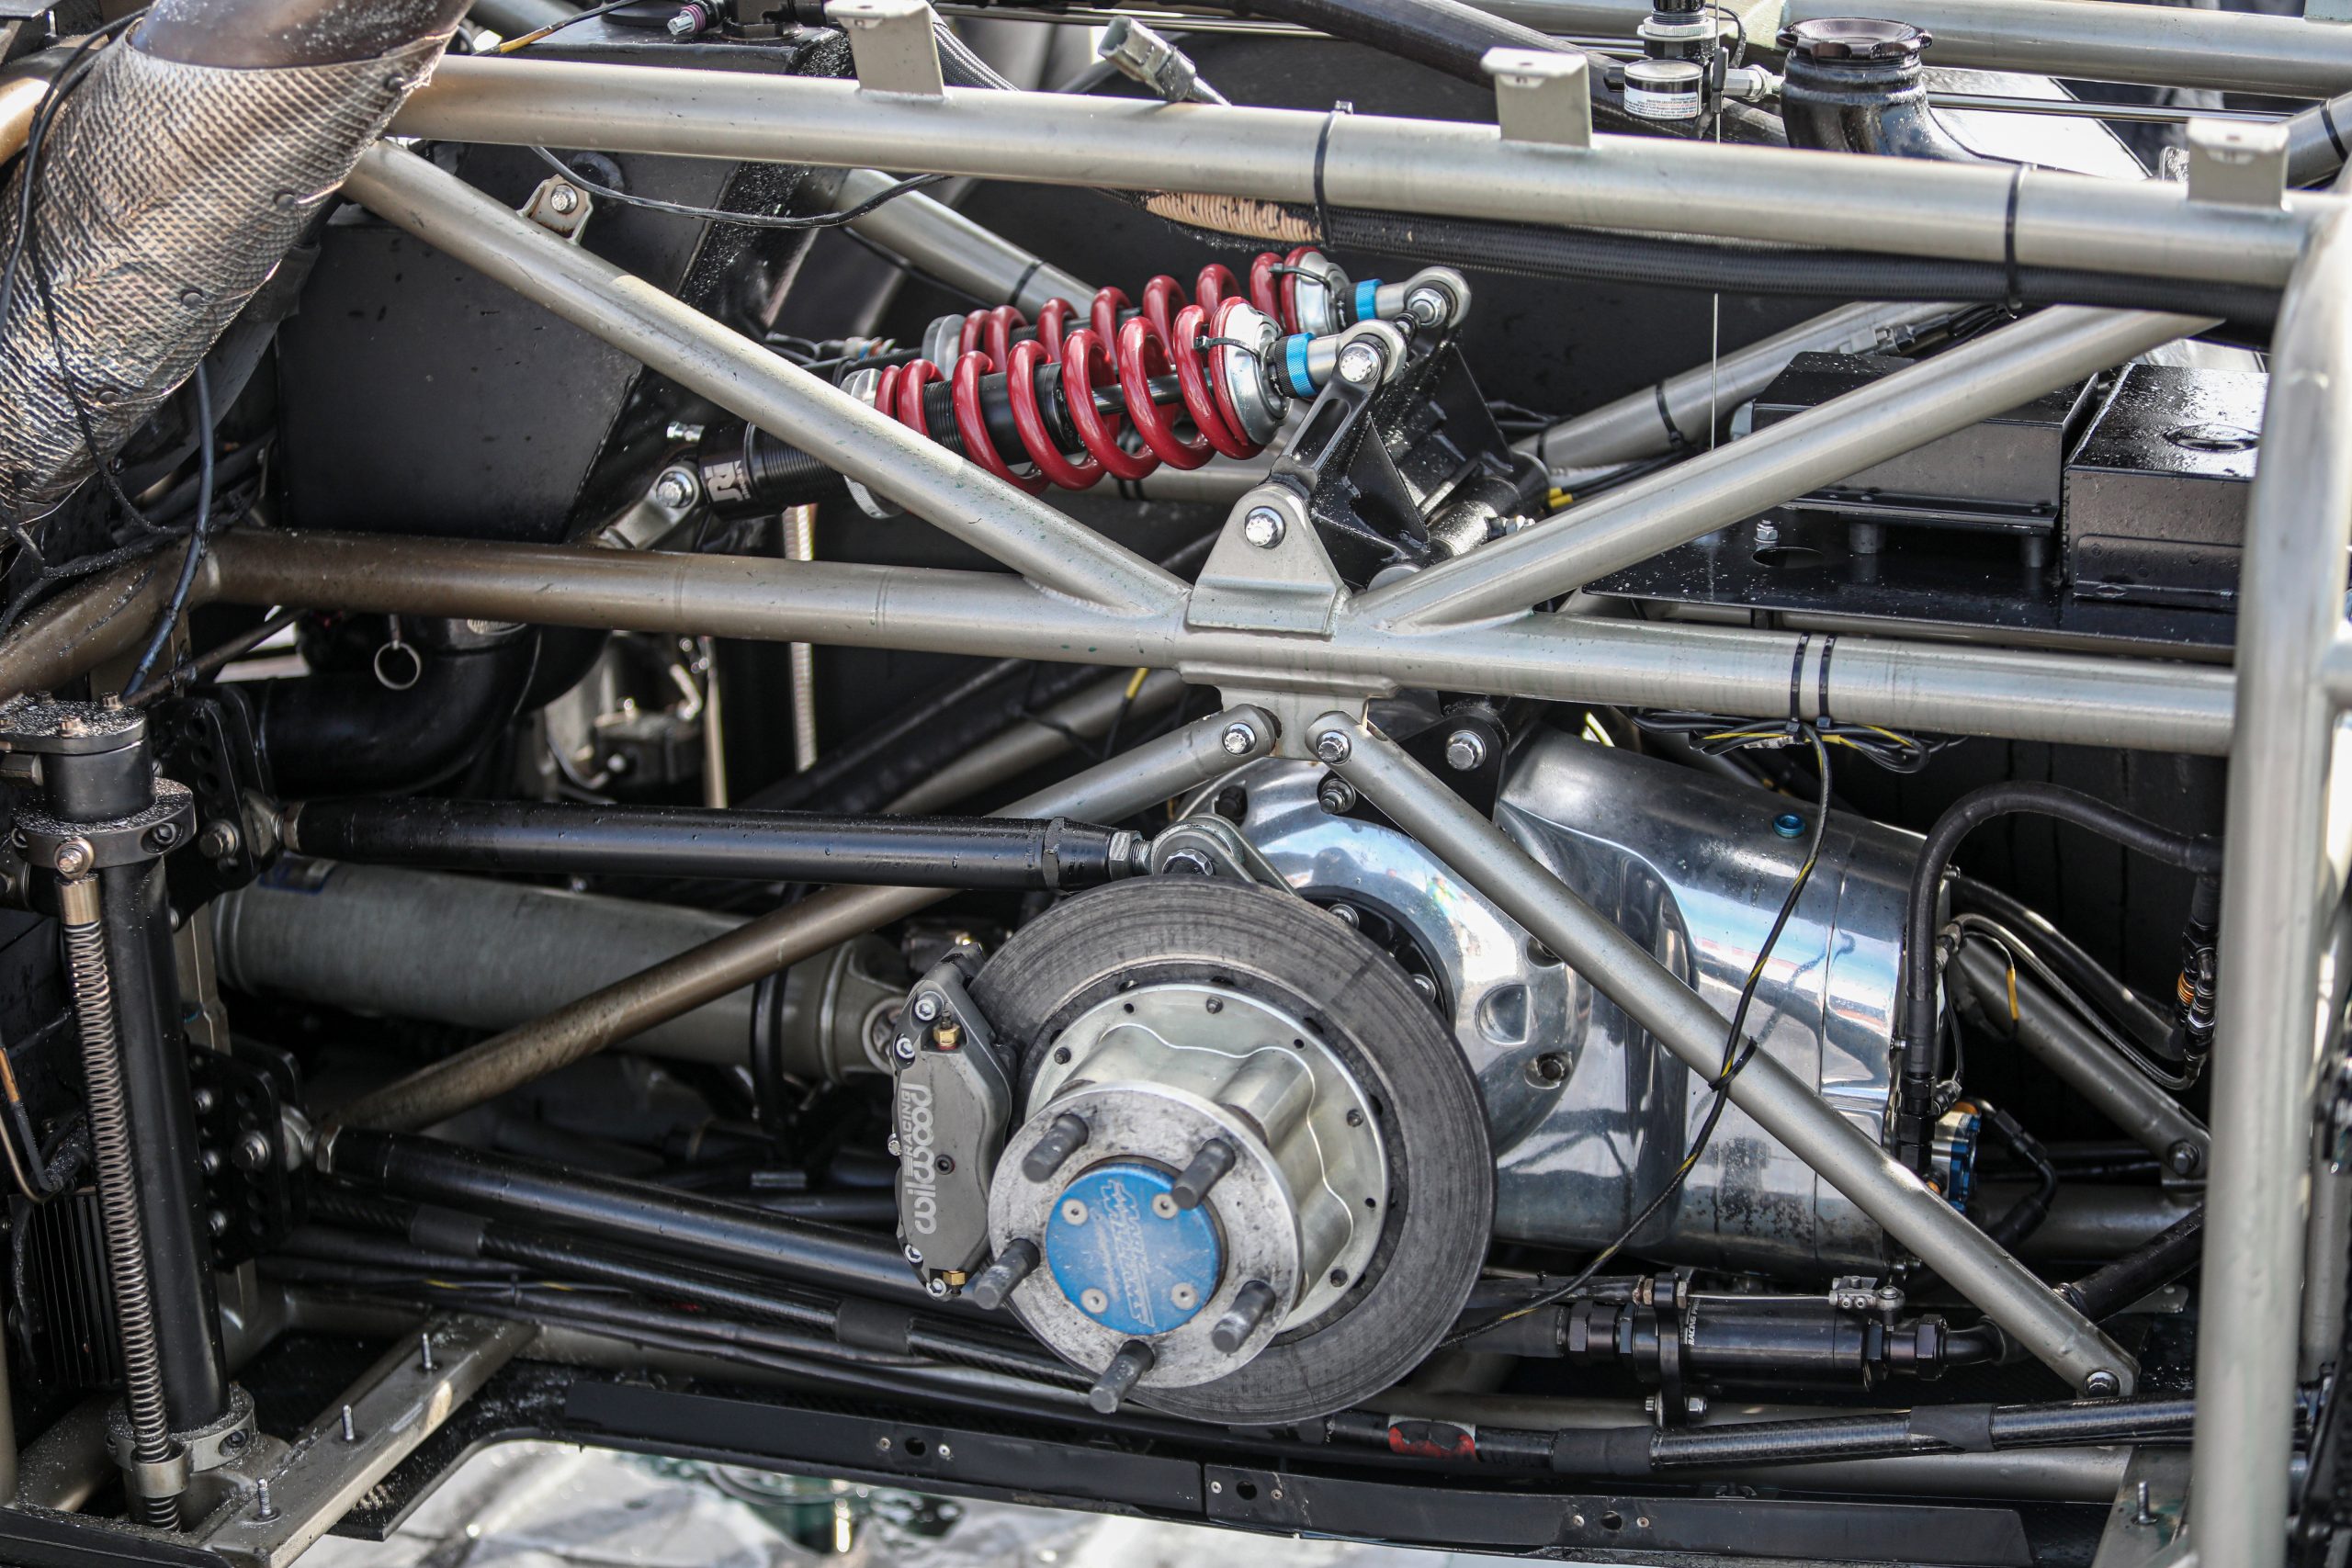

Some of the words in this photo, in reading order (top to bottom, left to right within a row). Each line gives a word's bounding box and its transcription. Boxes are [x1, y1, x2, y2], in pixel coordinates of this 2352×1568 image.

[901, 1090, 914, 1156] RACING
[900, 1082, 937, 1235] wilwood
[1688, 1316, 1697, 1346] RACING
